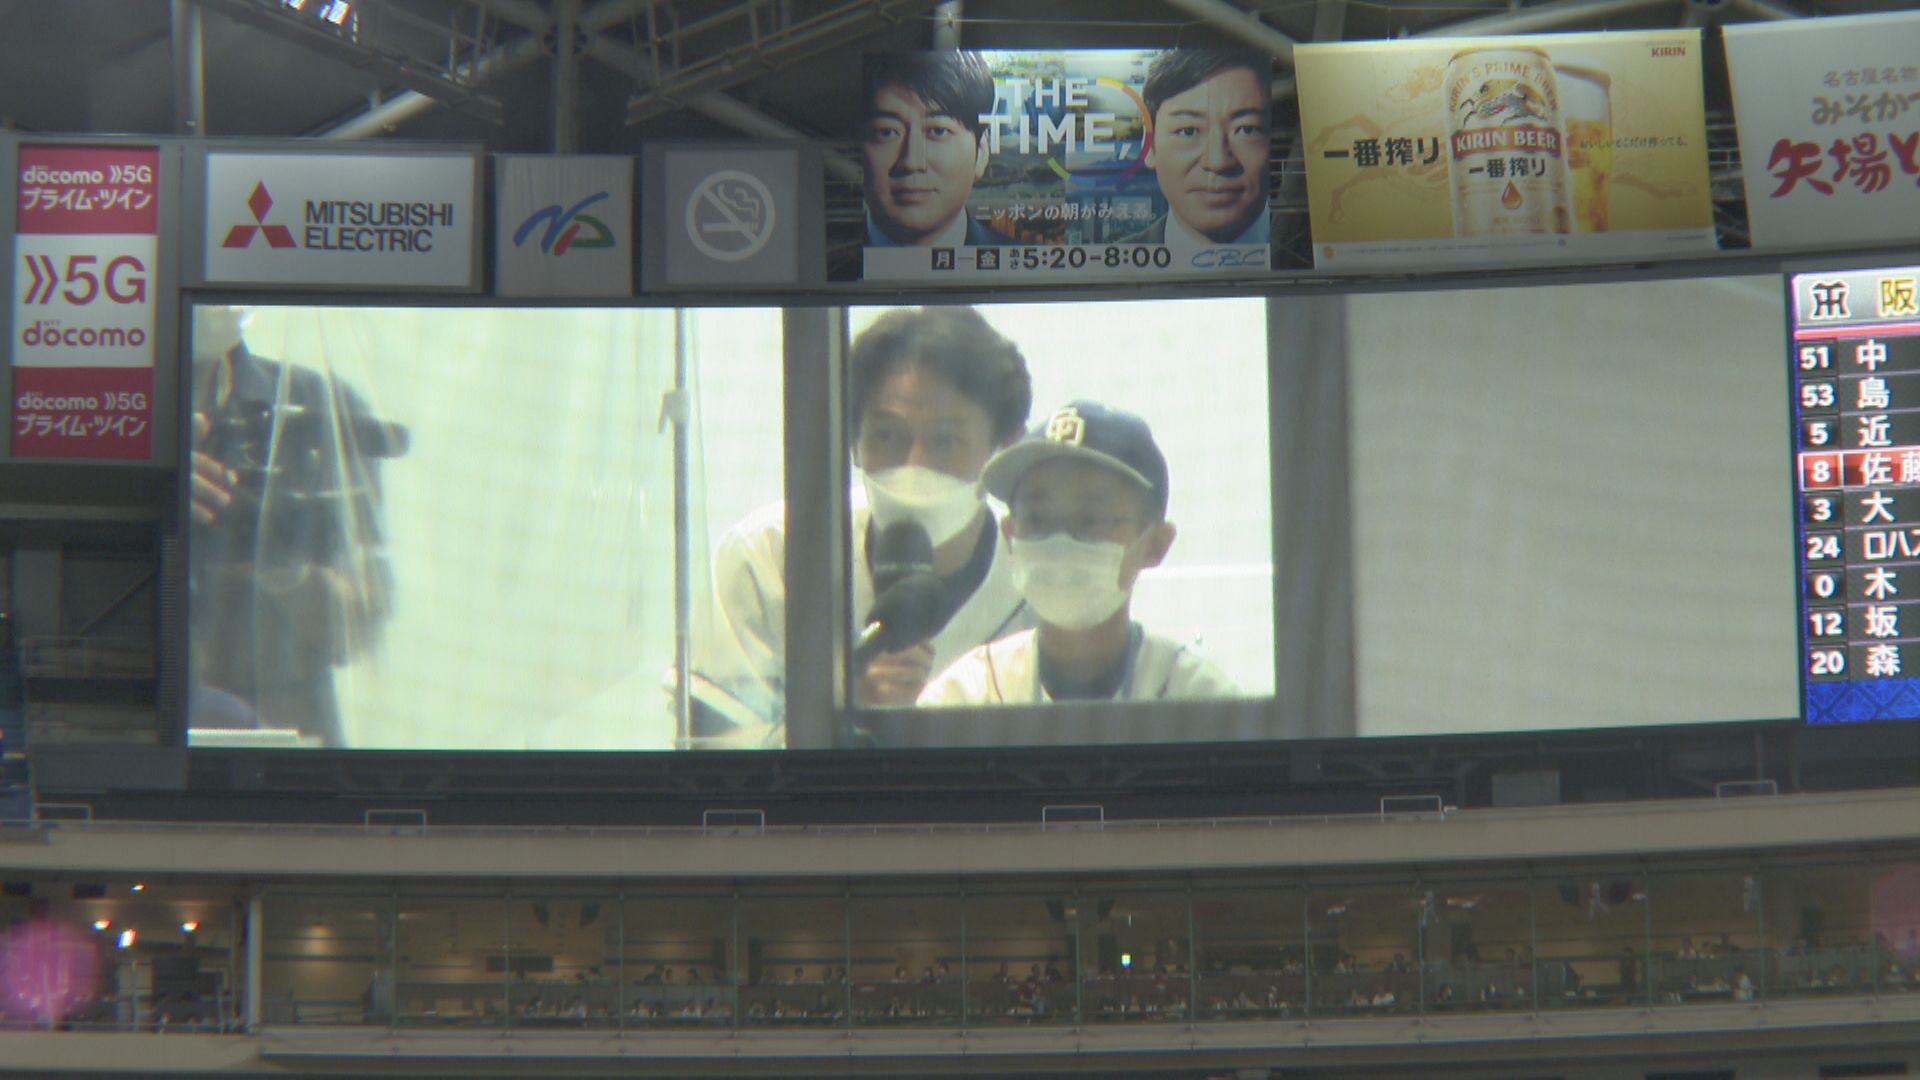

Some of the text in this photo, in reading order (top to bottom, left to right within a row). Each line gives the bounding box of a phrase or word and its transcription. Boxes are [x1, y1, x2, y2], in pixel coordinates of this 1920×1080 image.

[1651, 47, 1686, 57] KIRIN
[1005, 79, 1089, 109] THE
[1812, 92, 1920, 125] みそか
[978, 113, 1131, 160] TIME,
[1457, 131, 1556, 152] KIRIN BEER
[1323, 137, 1439, 168] 一番搾り
[1469, 157, 1546, 178] 一番搾り
[22, 165, 103, 184] docomo
[304, 200, 453, 227] MITSUBISHI
[304, 227, 432, 253] ELECTRIC
[1879, 277, 1917, 316] 阪
[22, 320, 145, 347] docomo
[1801, 340, 1887, 370] 51 中
[18, 391, 98, 410] docomo
[1801, 377, 1890, 408] 53 島
[1810, 416, 1892, 447] 5 近
[1812, 461, 1831, 482] 8
[1813, 491, 1895, 523] 3 大
[1807, 536, 1840, 559] 24
[1814, 567, 1897, 599] 0 木
[1810, 606, 1899, 637] 12 坂
[1811, 644, 1900, 676] 20 森
